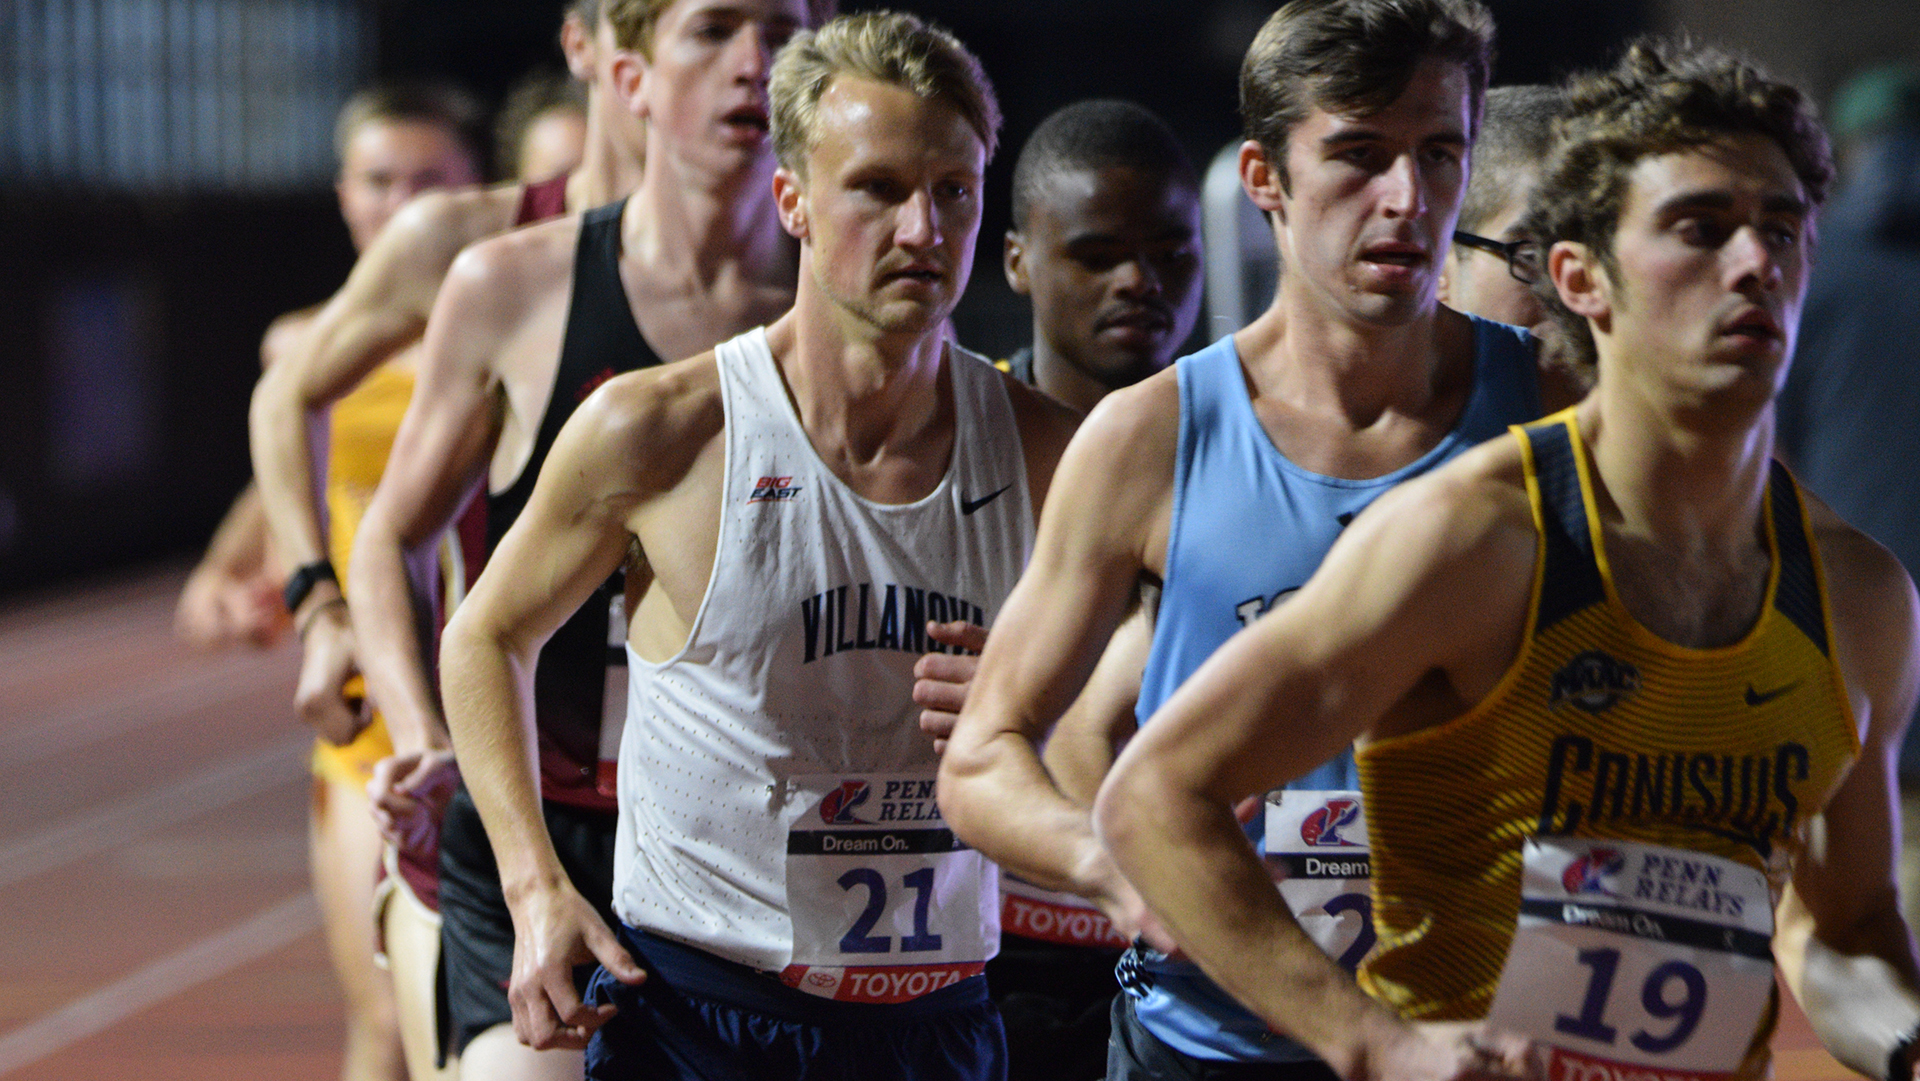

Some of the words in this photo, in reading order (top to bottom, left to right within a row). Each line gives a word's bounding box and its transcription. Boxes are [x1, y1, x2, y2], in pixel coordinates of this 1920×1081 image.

[750, 487, 803, 499] EAST
[755, 476, 793, 488] BIG
[883, 780, 937, 799] PEN
[1538, 735, 1809, 845] CANISIUS
[878, 802, 942, 821] RELA
[823, 835, 878, 851] Dream
[881, 835, 909, 850] On.
[1305, 858, 1369, 876] Dream
[1641, 853, 1723, 886] PENN
[1635, 876, 1745, 916] RELAYS
[836, 867, 942, 954] 21
[1322, 892, 1378, 966] 2
[1554, 947, 1708, 1055] 19
